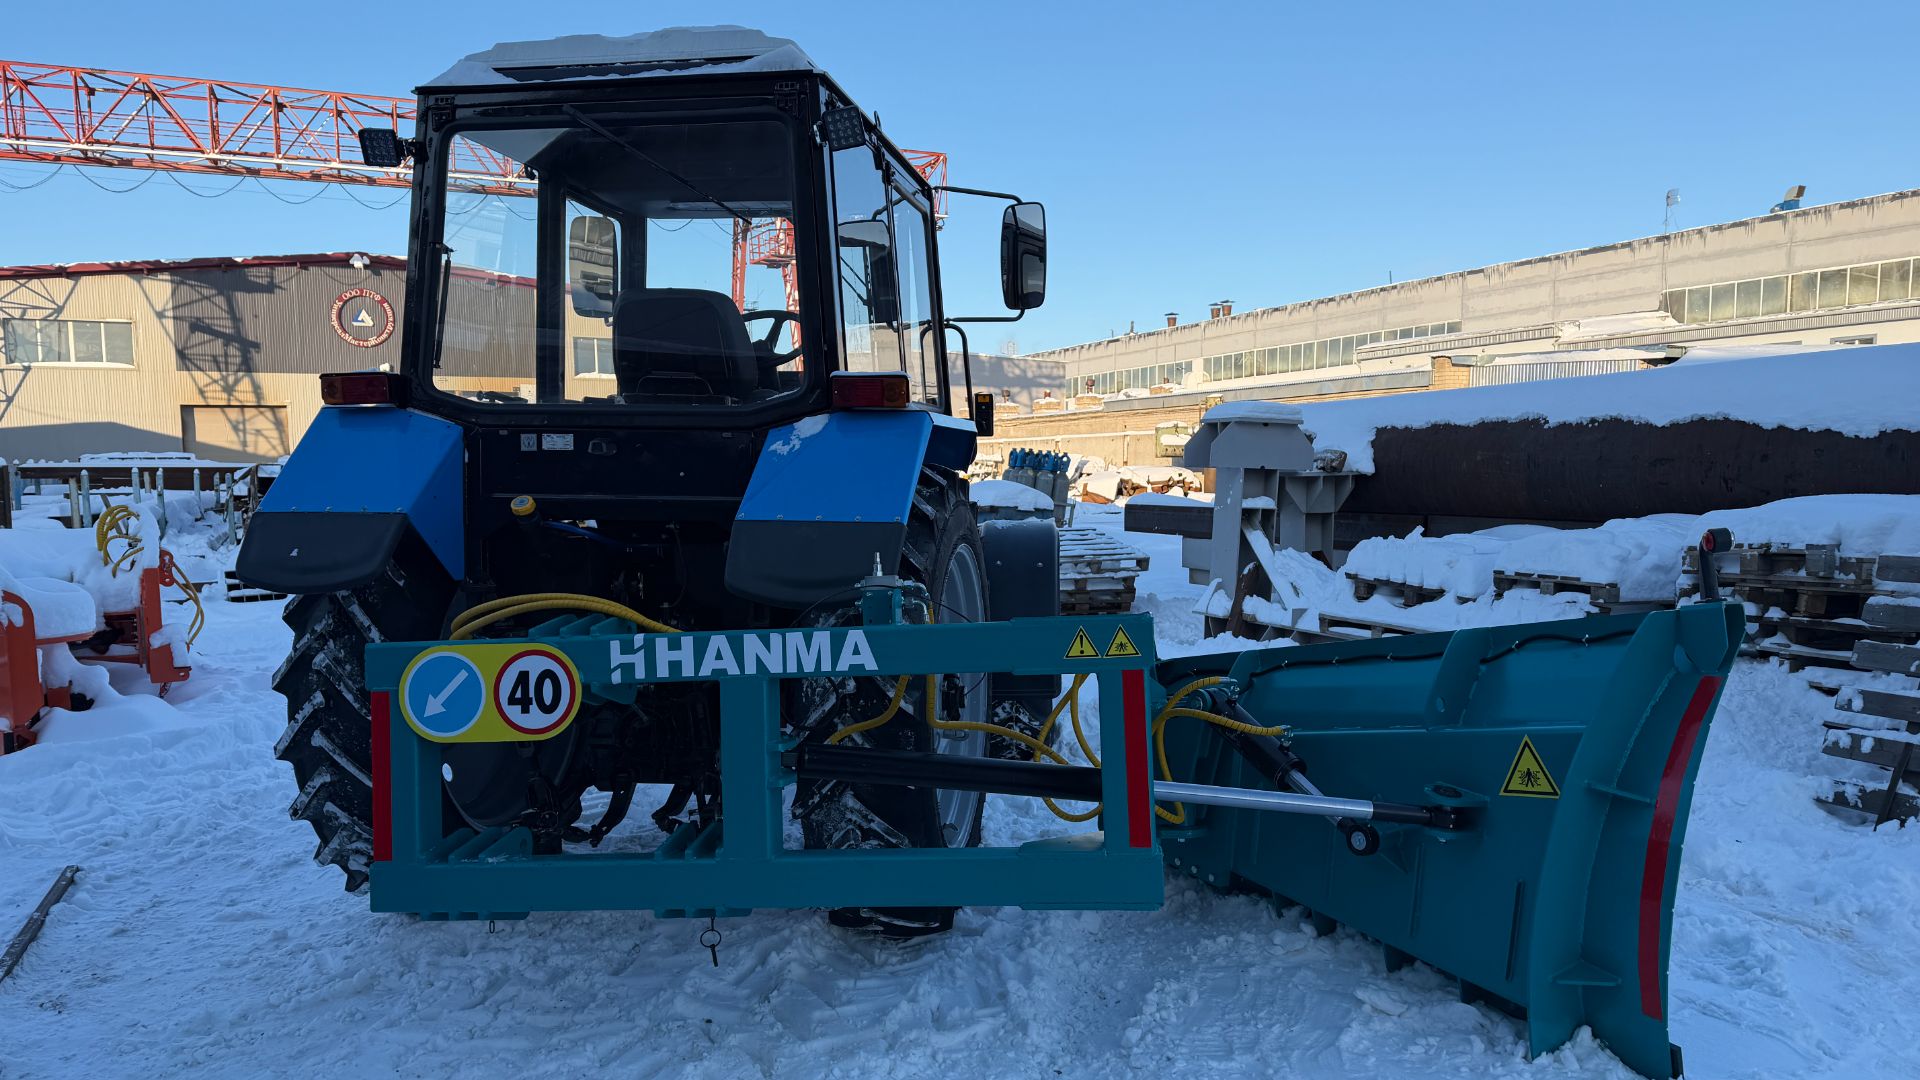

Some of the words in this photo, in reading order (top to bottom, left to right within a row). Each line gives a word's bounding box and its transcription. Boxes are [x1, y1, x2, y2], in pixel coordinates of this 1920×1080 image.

[341, 289, 359, 299] ООО
[362, 289, 380, 300] ПТФ
[655, 629, 879, 678] HANMA
[507, 668, 562, 715] 40
